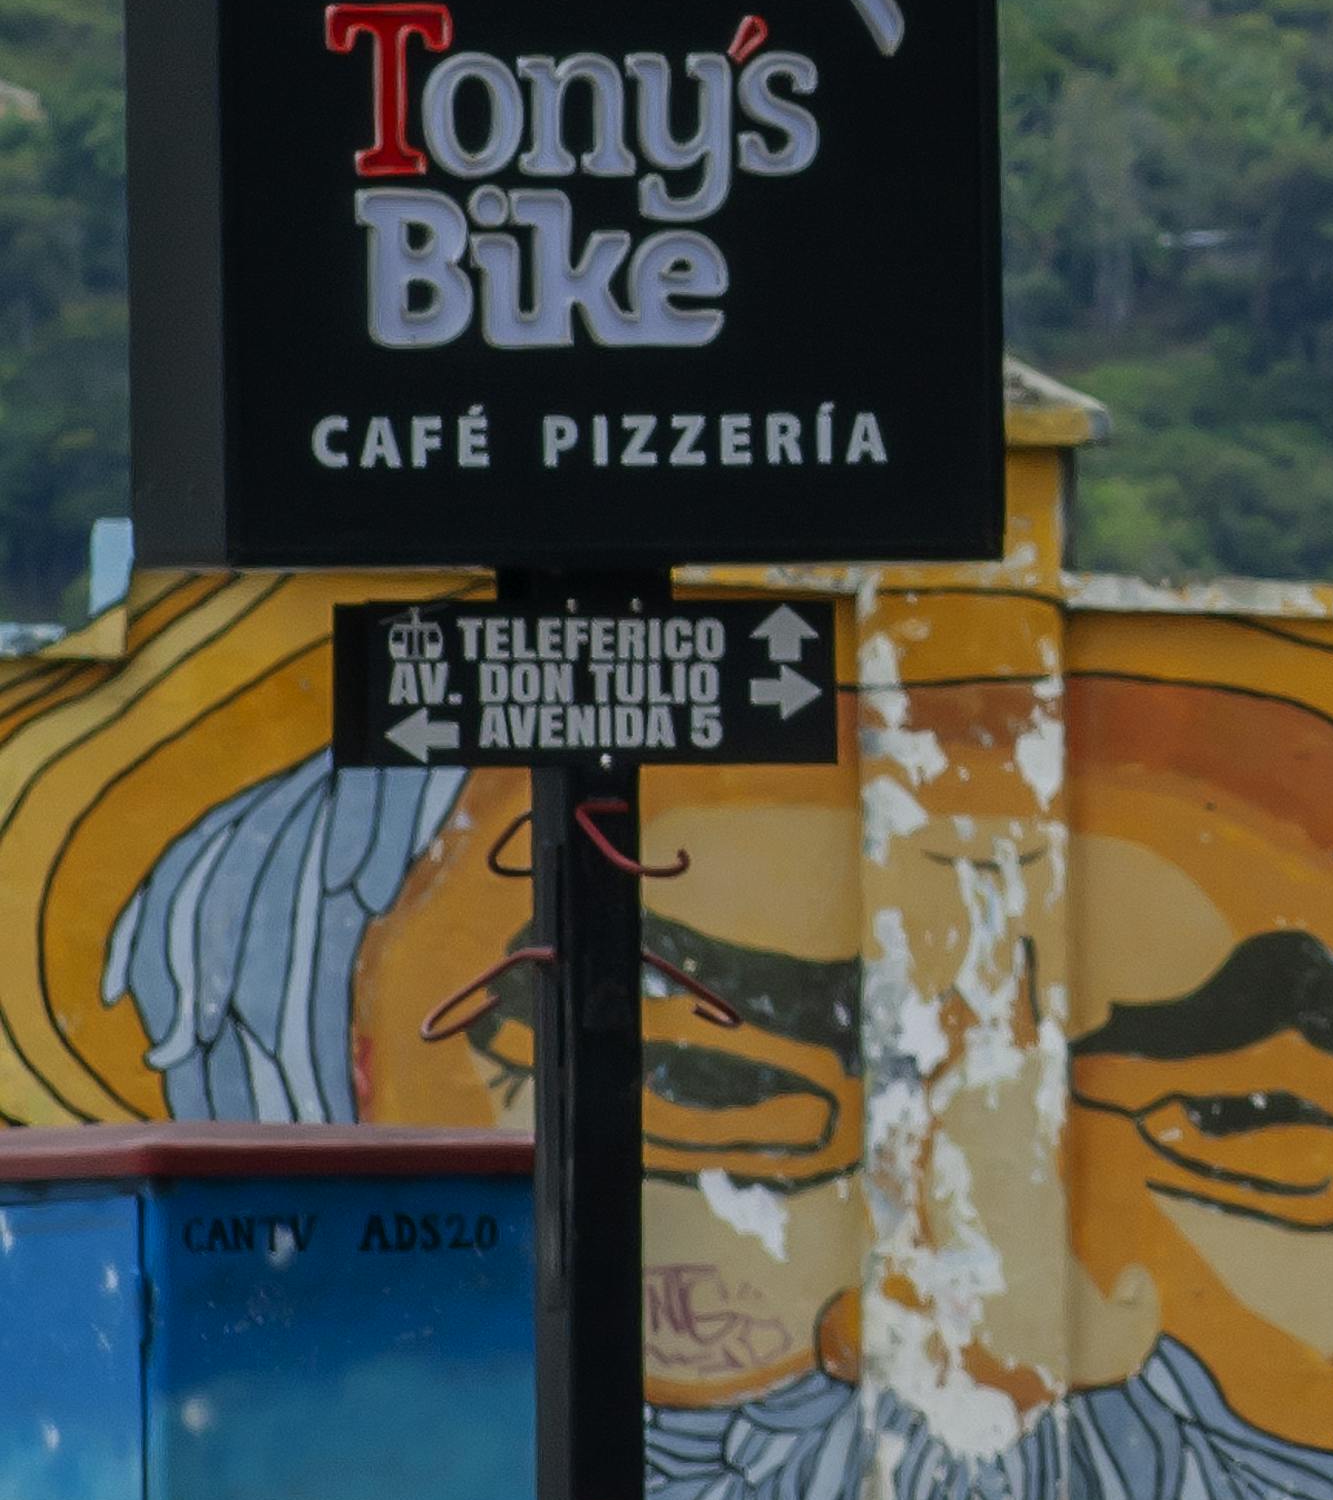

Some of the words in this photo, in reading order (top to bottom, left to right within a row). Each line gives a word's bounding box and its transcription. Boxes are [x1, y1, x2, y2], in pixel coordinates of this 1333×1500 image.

[355, 184, 730, 349] Bike
[311, 403, 491, 470] CAFÉ
[541, 400, 889, 468] PIZZERÍA
[456, 616, 727, 662] TELEFERICO
[388, 661, 462, 705] AV.
[479, 661, 574, 705] DON
[588, 661, 721, 705] TULIO
[478, 704, 676, 749] AVENIDA
[690, 704, 724, 749] 5
[182, 1212, 318, 1253] CANTV
